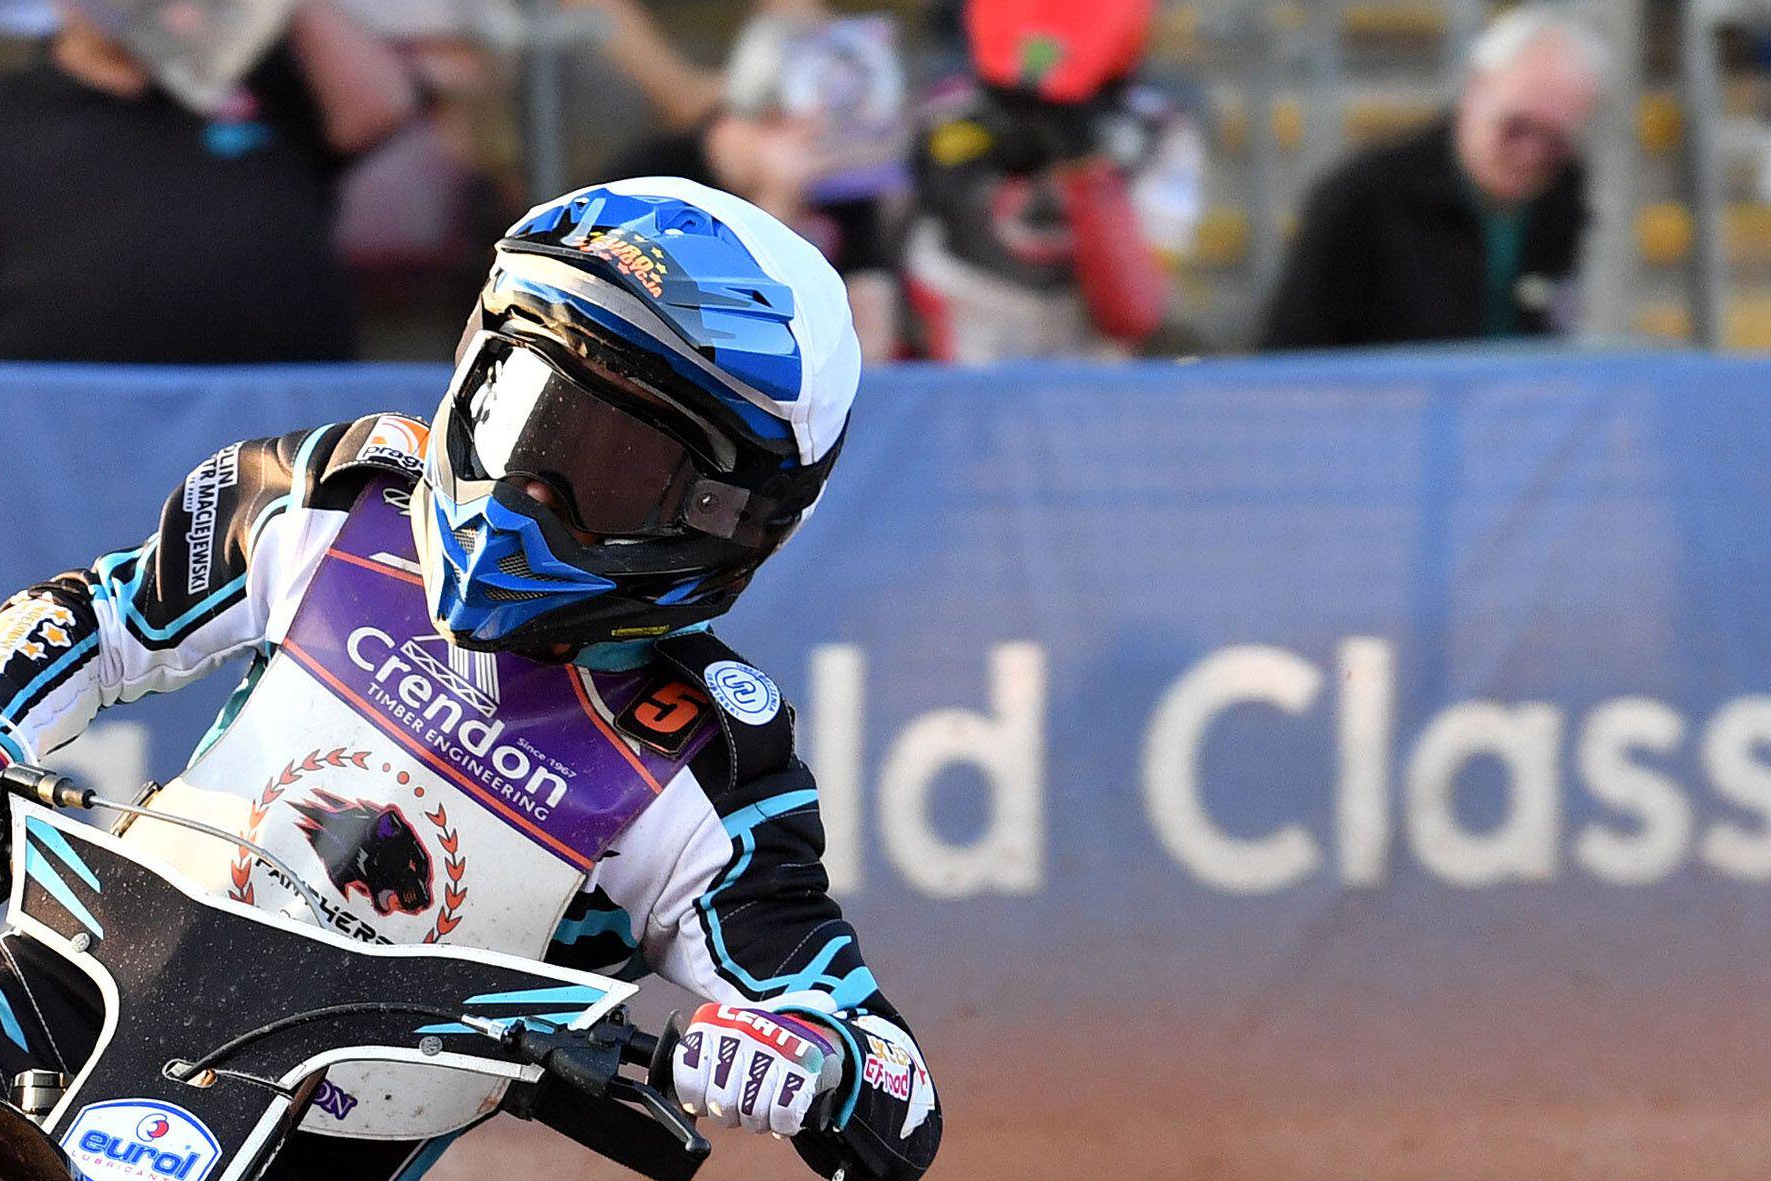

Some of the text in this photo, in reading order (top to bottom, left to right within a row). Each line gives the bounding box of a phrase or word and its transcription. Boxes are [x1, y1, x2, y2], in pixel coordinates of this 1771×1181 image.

[189, 483, 216, 592] MACIEJEWSKI
[346, 626, 568, 809] Crendon
[634, 681, 710, 733] 5
[367, 681, 550, 822] TIMBER ENGINEERING
[516, 736, 578, 779] Since 1967
[716, 1003, 812, 1058] LEATT
